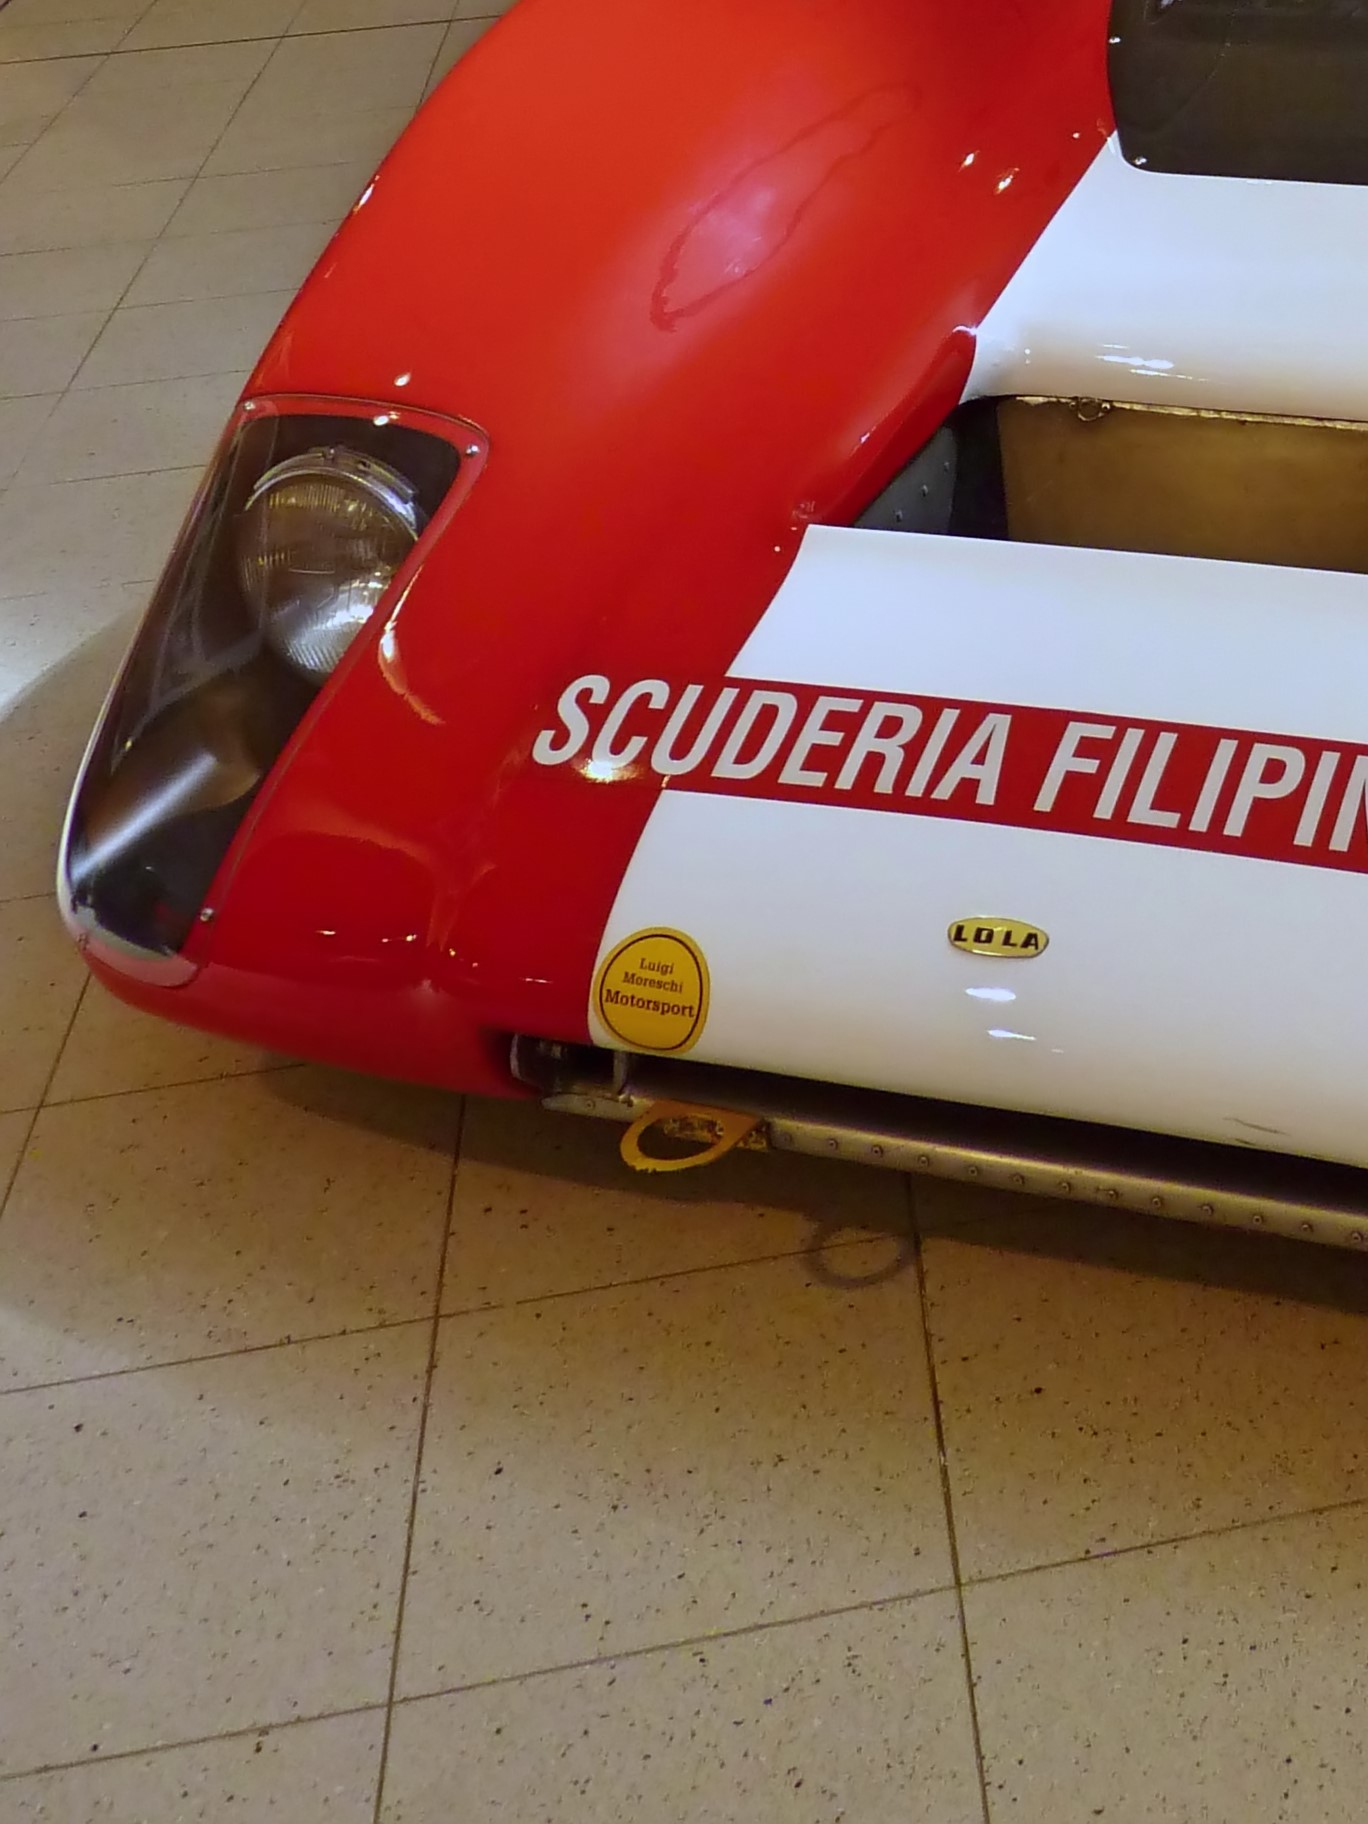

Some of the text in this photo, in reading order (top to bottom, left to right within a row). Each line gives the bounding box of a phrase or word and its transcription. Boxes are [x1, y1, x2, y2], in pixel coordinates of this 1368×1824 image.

[531, 673, 1013, 806] SCUDERIA
[952, 924, 1040, 951] LOLA
[639, 957, 676, 977] Luigi
[622, 971, 684, 995] Moreschi
[604, 988, 696, 1019] Motorsport
